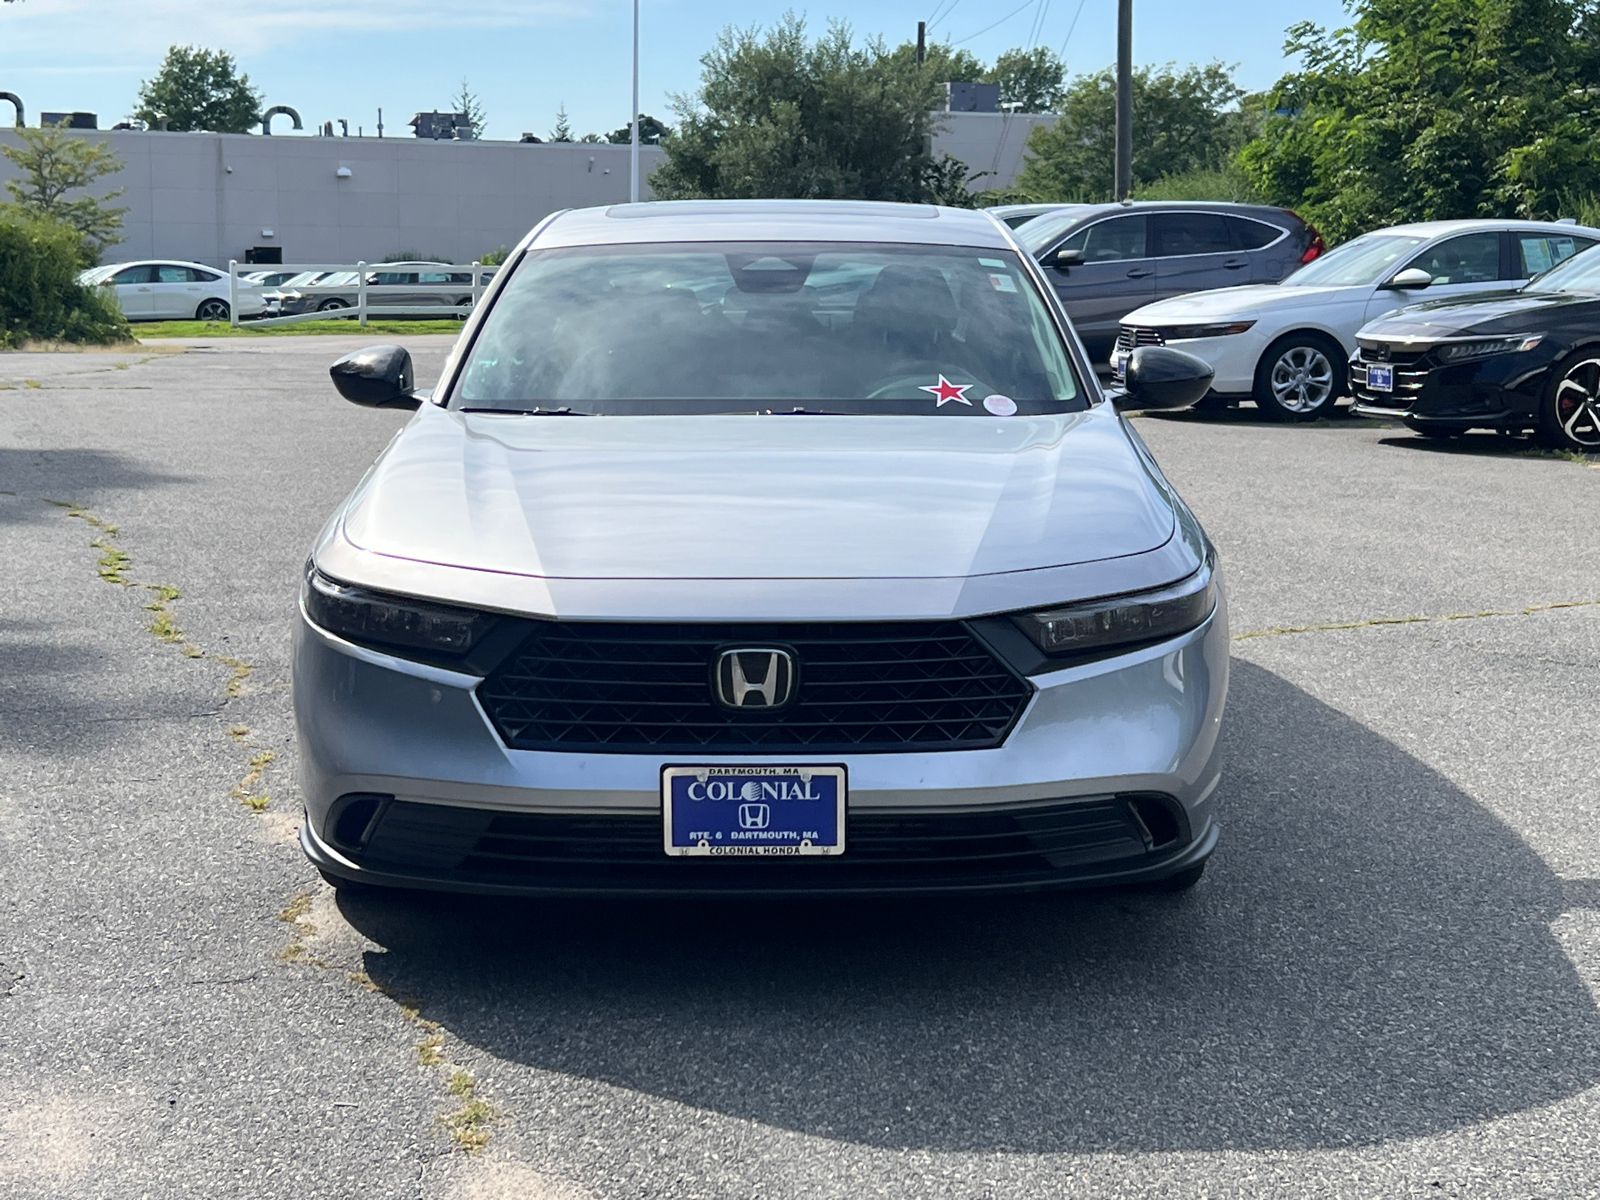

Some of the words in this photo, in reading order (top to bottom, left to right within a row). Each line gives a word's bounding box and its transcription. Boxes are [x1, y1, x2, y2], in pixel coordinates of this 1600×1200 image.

[687, 781, 820, 801] COLONIAL
[689, 831, 713, 840] RTE.
[715, 831, 723, 840] 6
[730, 831, 800, 841] DARTMOUTH,
[803, 831, 819, 839] MA
[709, 847, 760, 855] COLONIAL
[764, 847, 800, 855] HONDA
